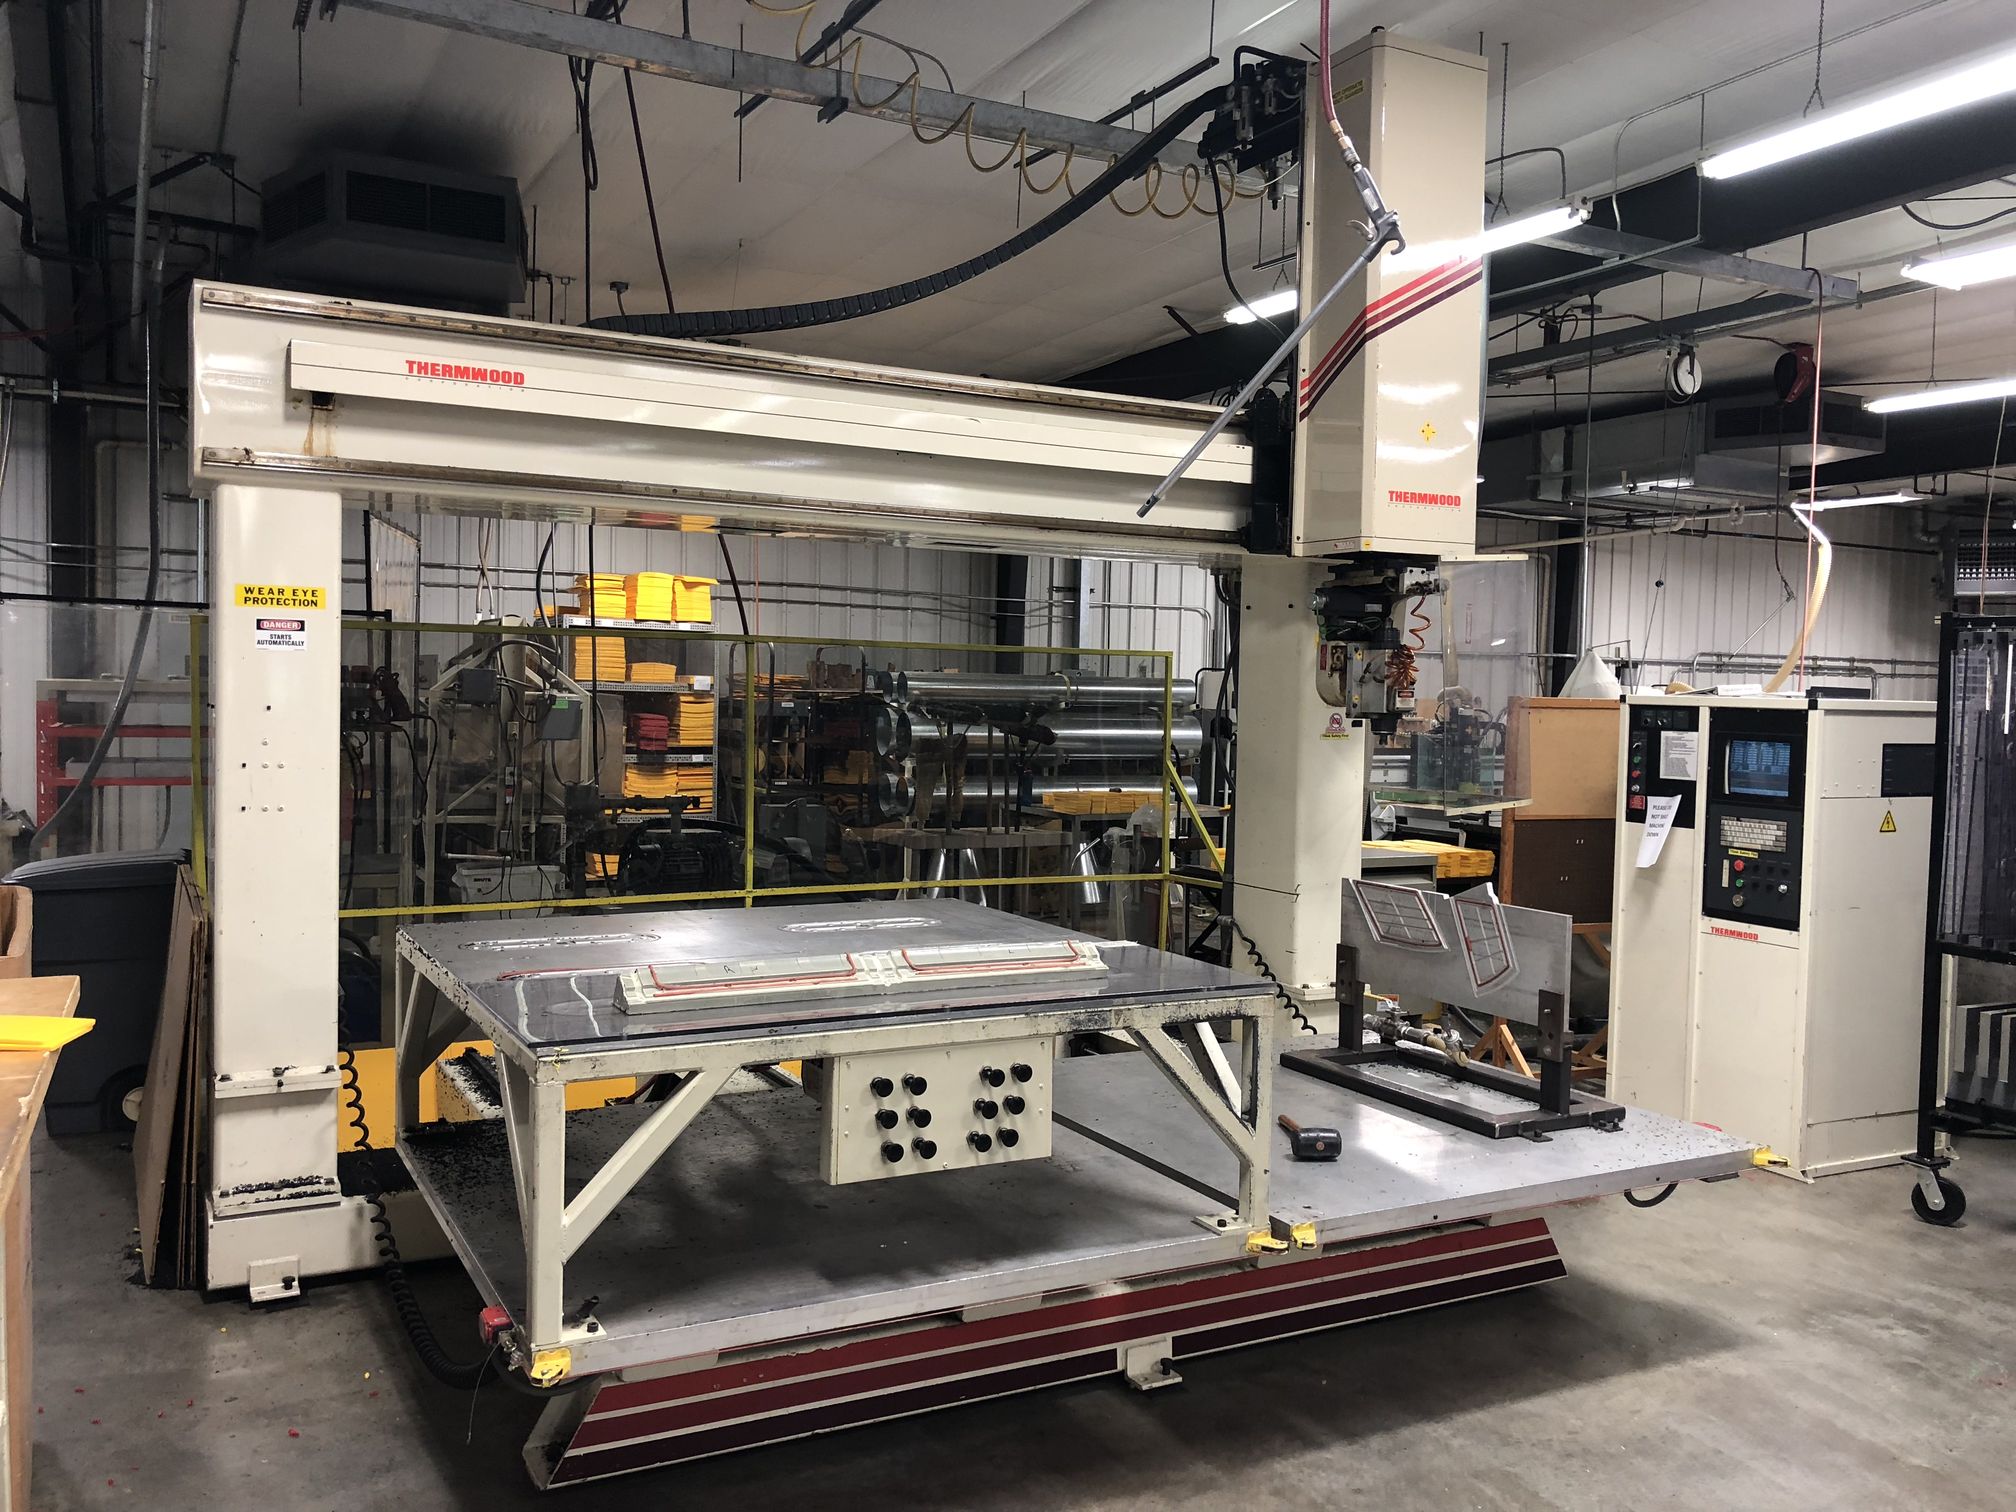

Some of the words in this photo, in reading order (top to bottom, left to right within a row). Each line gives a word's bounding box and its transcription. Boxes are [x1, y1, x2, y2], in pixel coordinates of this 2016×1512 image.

[405, 360, 525, 385] THERMWOOD
[1388, 490, 1462, 507] THERMWOOD
[244, 586, 285, 596] WEAR
[292, 588, 319, 598] EYE
[243, 596, 318, 607] PROTECTION
[263, 621, 299, 629] DANGER
[256, 639, 305, 647] AUTOMATICALLY
[1710, 926, 1759, 940] THERMWOOD
